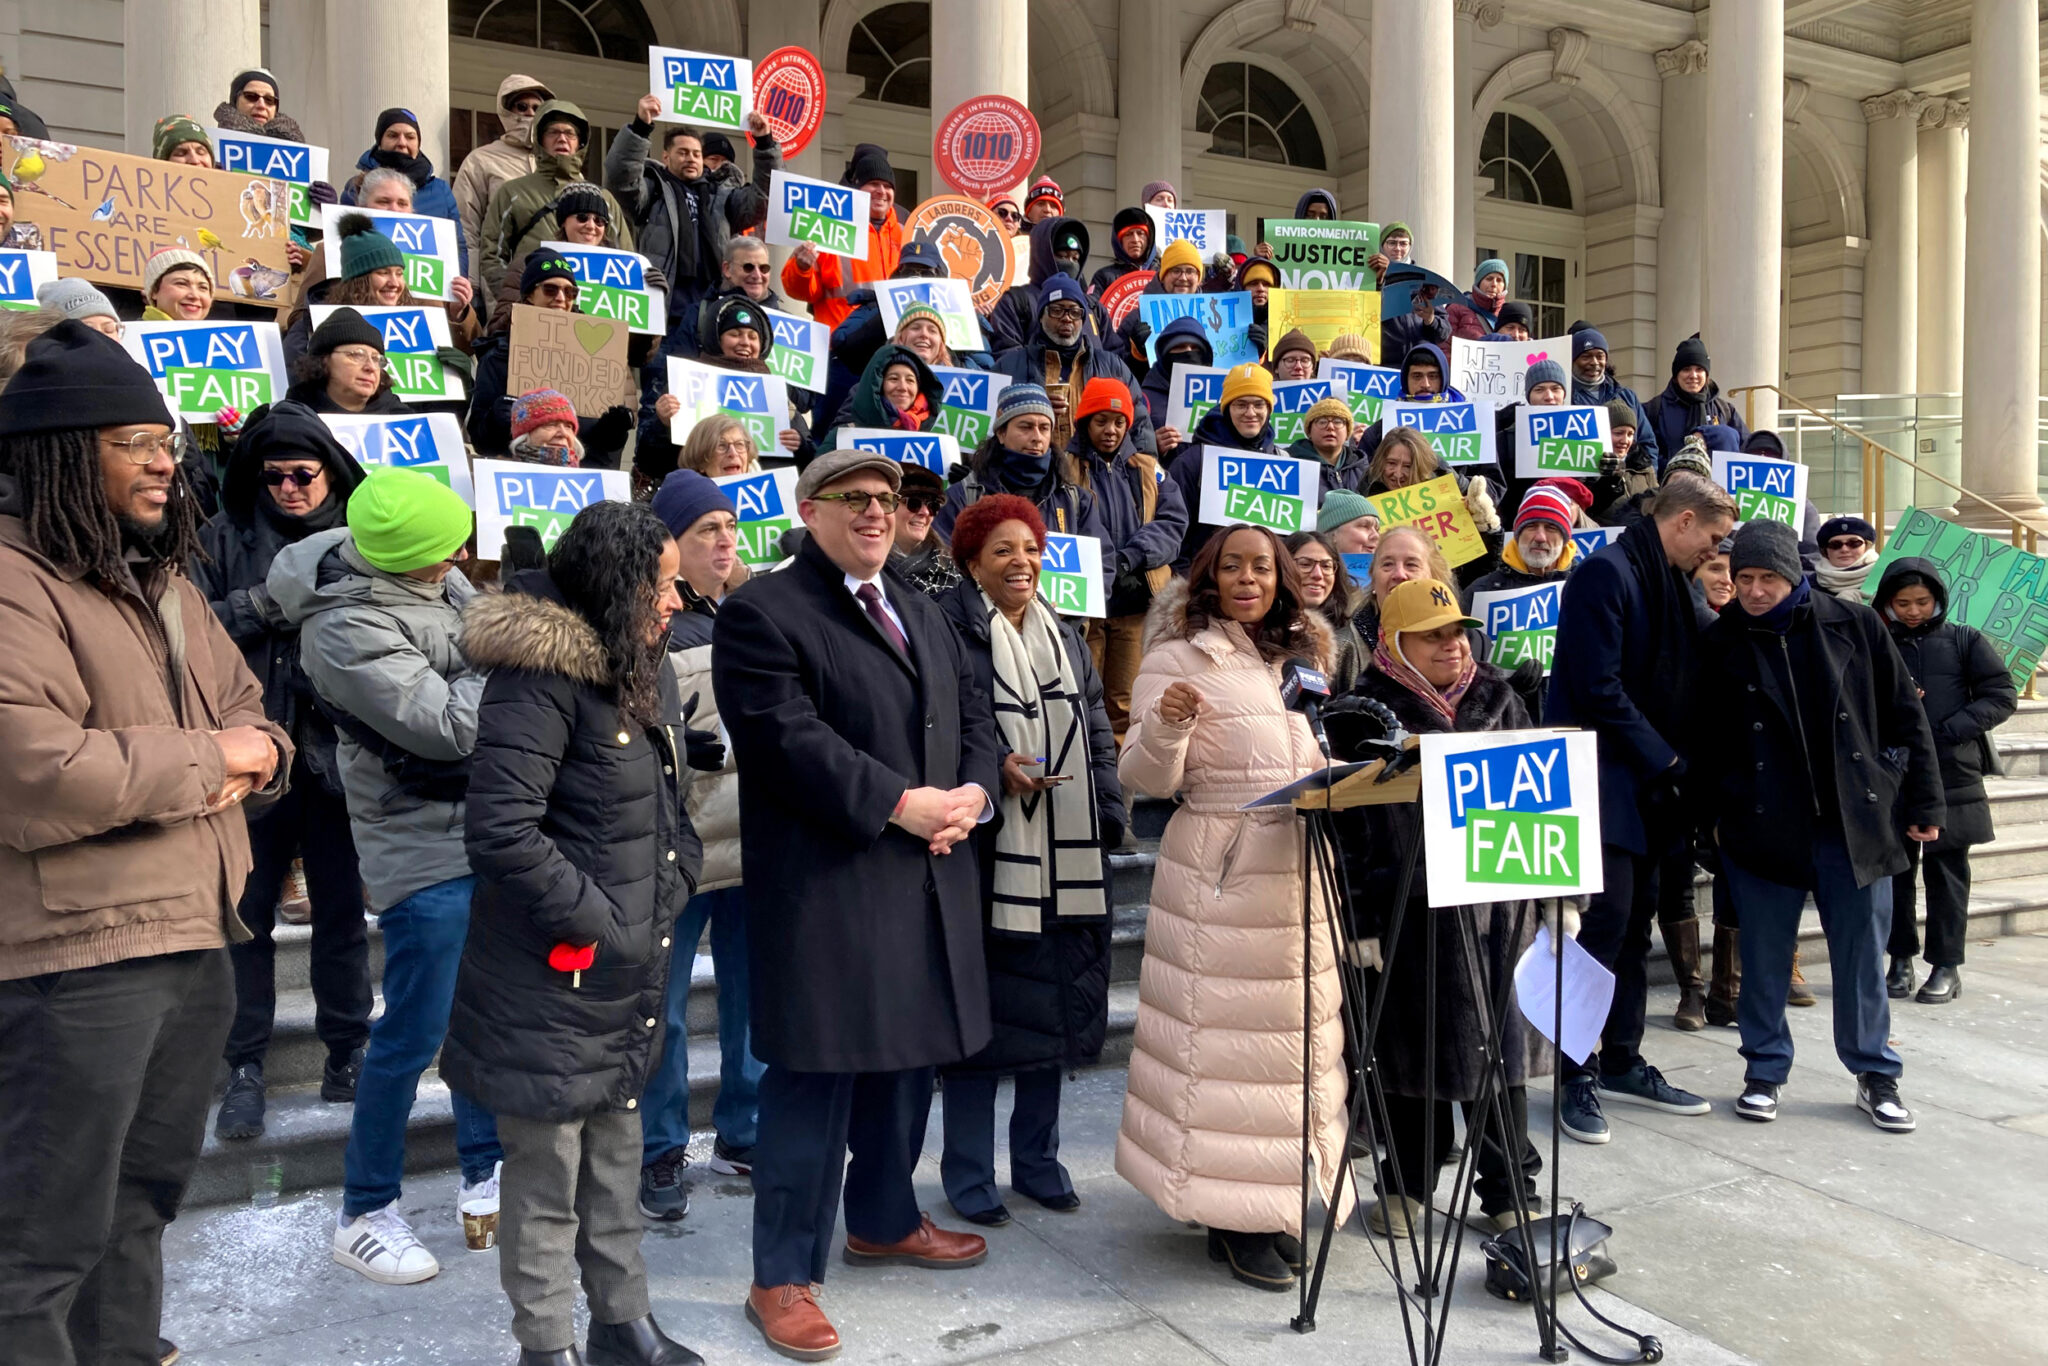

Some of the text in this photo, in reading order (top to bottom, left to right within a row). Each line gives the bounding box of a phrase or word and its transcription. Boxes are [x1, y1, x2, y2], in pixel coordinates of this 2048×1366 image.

[668, 61, 731, 87] PLAY
[677, 87, 736, 122] FAIR
[766, 86, 806, 125] 1010
[781, 55, 821, 96] INTERNATIONAL
[808, 100, 821, 131] UNION
[963, 132, 1013, 160] 1010
[968, 102, 1030, 129] INTERNATIONAL
[1024, 131, 1033, 160] UNION
[225, 145, 304, 178] PLAY
[82, 159, 214, 220] PARKS
[959, 177, 980, 189] North
[982, 174, 1016, 189] America
[788, 186, 848, 215] PLAY
[927, 203, 982, 221] LABORERS
[111, 211, 171, 236] ARE
[794, 212, 850, 250] FAIR
[1165, 212, 1206, 225] SAVE
[1165, 223, 1206, 241] NYC
[1275, 226, 1369, 241] ENVIRONMENTAL
[392, 222, 428, 250] AY
[50, 226, 231, 290] ESSENL
[1275, 243, 1366, 267] JUSTICE
[409, 259, 437, 291] IR
[1279, 268, 1364, 291] NOW
[576, 286, 643, 325] FAIR
[384, 315, 420, 350] AY
[539, 313, 568, 351] I
[774, 320, 806, 346] AY
[149, 331, 248, 372] PLAY
[1463, 345, 1500, 371] WE
[383, 357, 440, 390] AIR
[512, 345, 625, 391] FUNDED
[1462, 370, 1506, 395] NYC
[173, 372, 263, 409] FAIR
[942, 377, 983, 405] AY
[930, 409, 980, 445] AIR
[1401, 408, 1469, 433] PLAY
[1534, 413, 1592, 441] PLAY
[1431, 437, 1475, 457] AIR
[1542, 442, 1599, 470] FAIR
[1222, 461, 1294, 490] PLAY
[1731, 465, 1791, 493] PLAY
[501, 477, 596, 511] PLAY
[736, 480, 770, 520] AY
[1229, 488, 1295, 529] FAIR
[1738, 492, 1789, 523] FAIR
[736, 525, 783, 559] AIR
[1893, 510, 2012, 581] PLAY
[1430, 586, 1452, 607] NY
[1493, 592, 1553, 632] PLAY
[1981, 591, 2048, 657] BE
[1497, 635, 1555, 666] FAIR
[1452, 748, 1560, 817] PLAY
[1472, 819, 1573, 877] FAIR
